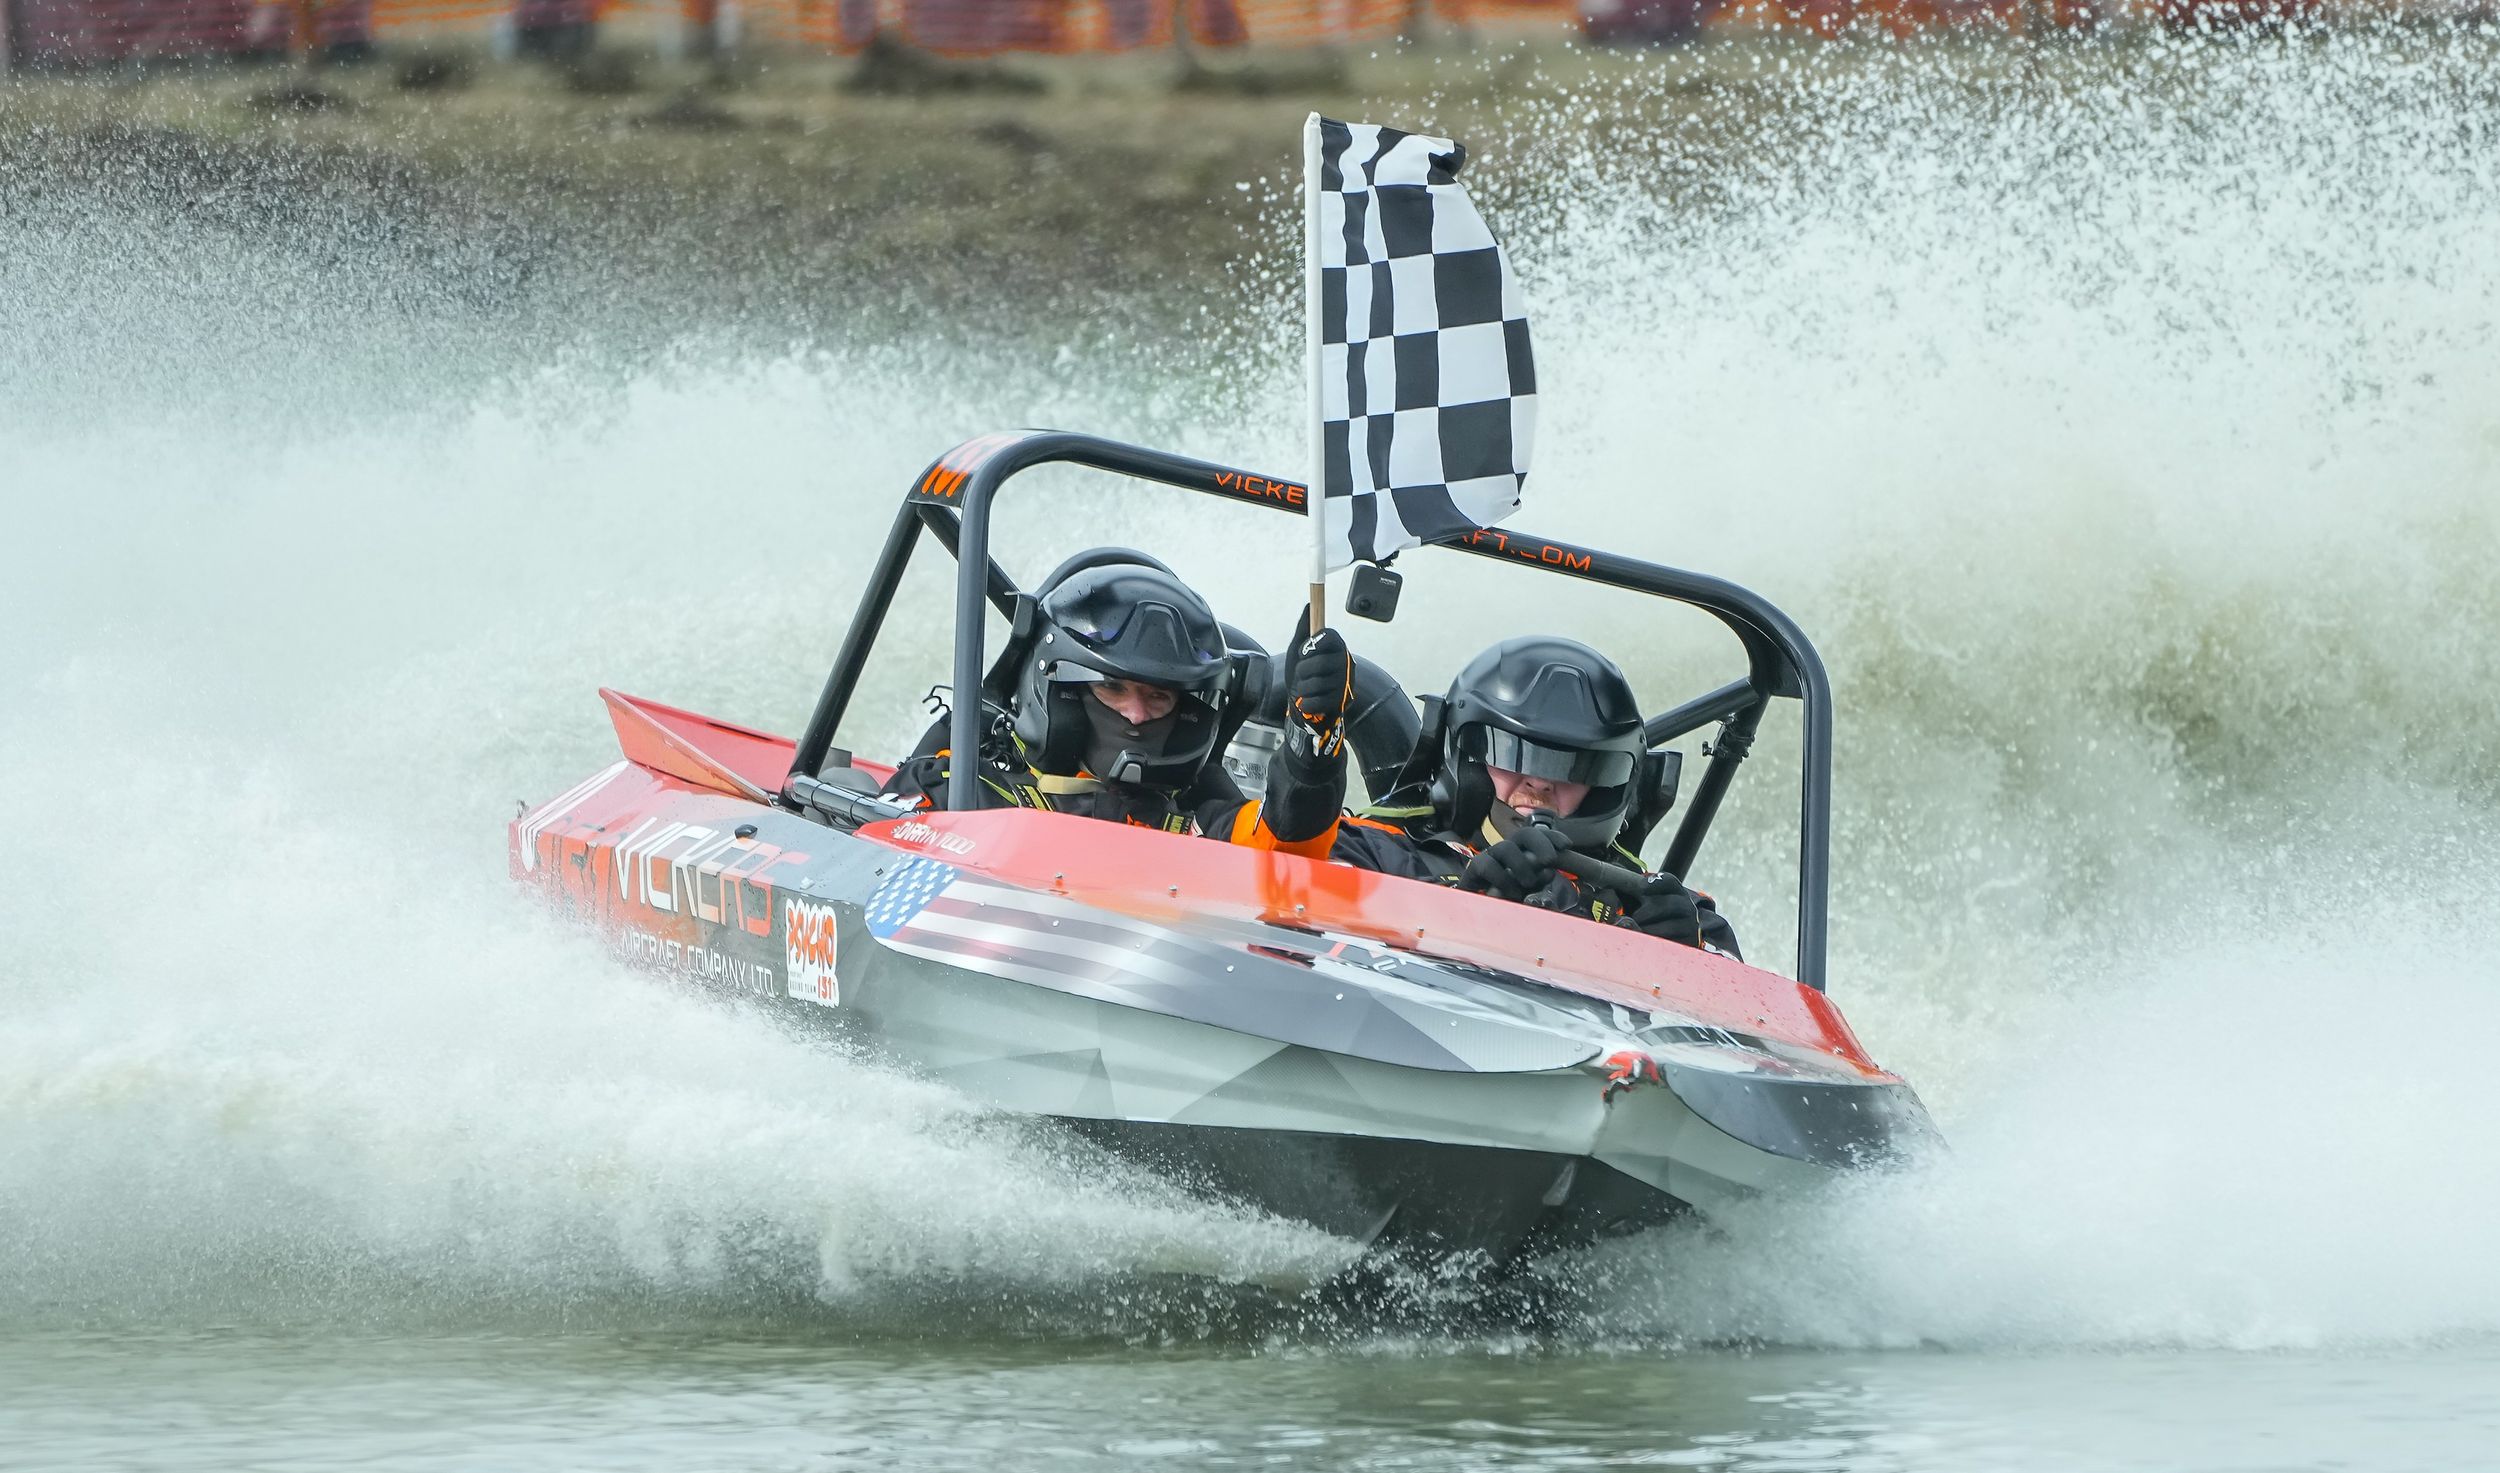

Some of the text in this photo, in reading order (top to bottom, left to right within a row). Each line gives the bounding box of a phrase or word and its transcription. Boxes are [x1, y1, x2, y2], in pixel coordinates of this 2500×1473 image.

[614, 816, 812, 937] VICKERS
[623, 930, 685, 974] AIRCRAFT
[687, 945, 747, 990] COMPANY
